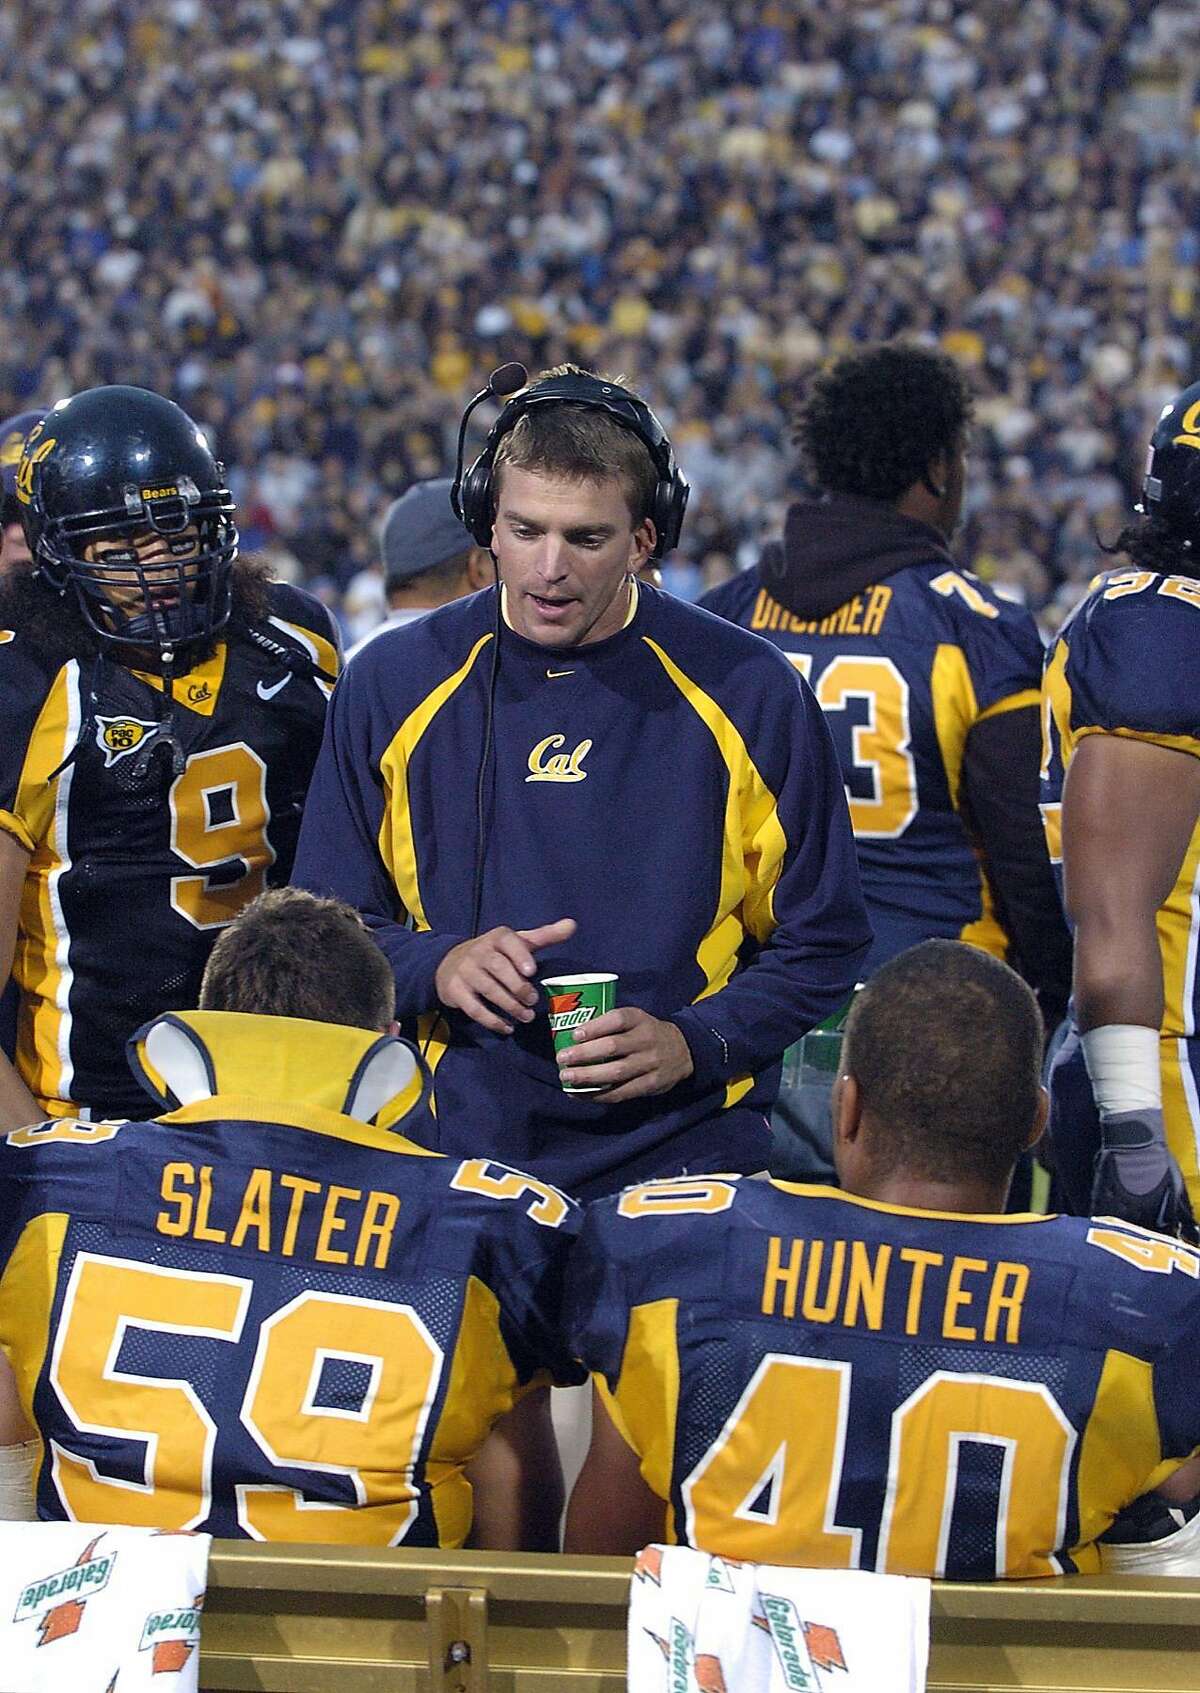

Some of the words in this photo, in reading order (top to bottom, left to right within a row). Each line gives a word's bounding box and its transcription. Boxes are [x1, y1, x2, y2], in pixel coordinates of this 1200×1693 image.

[142, 486, 177, 500] Bears
[188, 682, 212, 704] Cal
[111, 738, 133, 748] 10
[525, 733, 593, 783] Cal
[784, 652, 918, 839] 3
[169, 741, 276, 930] 9
[156, 1161, 401, 1270] SLATER
[449, 1158, 571, 1228] 5
[617, 1173, 742, 1219] 0
[1086, 1216, 1200, 1279] 4
[761, 1236, 1031, 1345] HUNTER
[50, 1251, 444, 1547] 59
[681, 1352, 1078, 1578] 40
[22, 1558, 110, 1609] Gatorade
[765, 1598, 811, 1688] Gatorade
